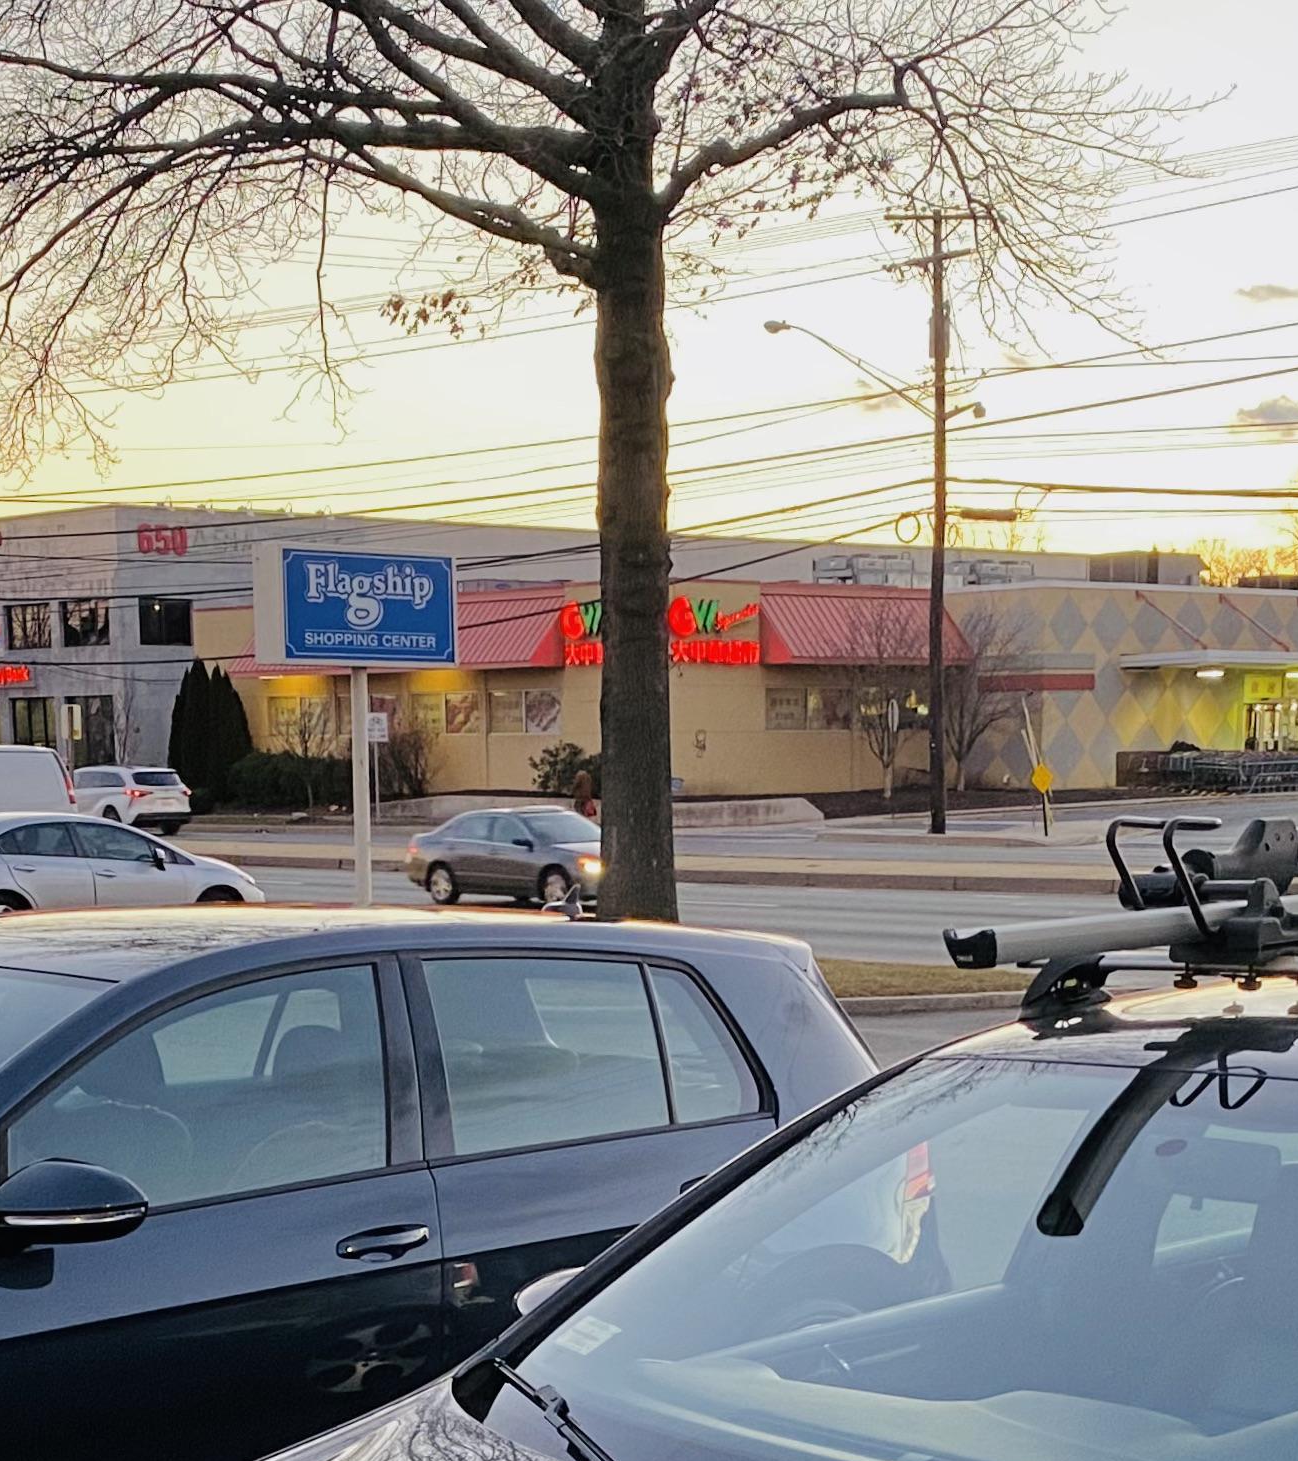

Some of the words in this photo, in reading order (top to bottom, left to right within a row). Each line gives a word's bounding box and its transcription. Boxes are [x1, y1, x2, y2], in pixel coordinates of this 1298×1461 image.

[137, 523, 189, 556] 650
[303, 560, 434, 630] Flagship
[305, 631, 378, 647] SHOPPING
[382, 635, 437, 649] CENTER
